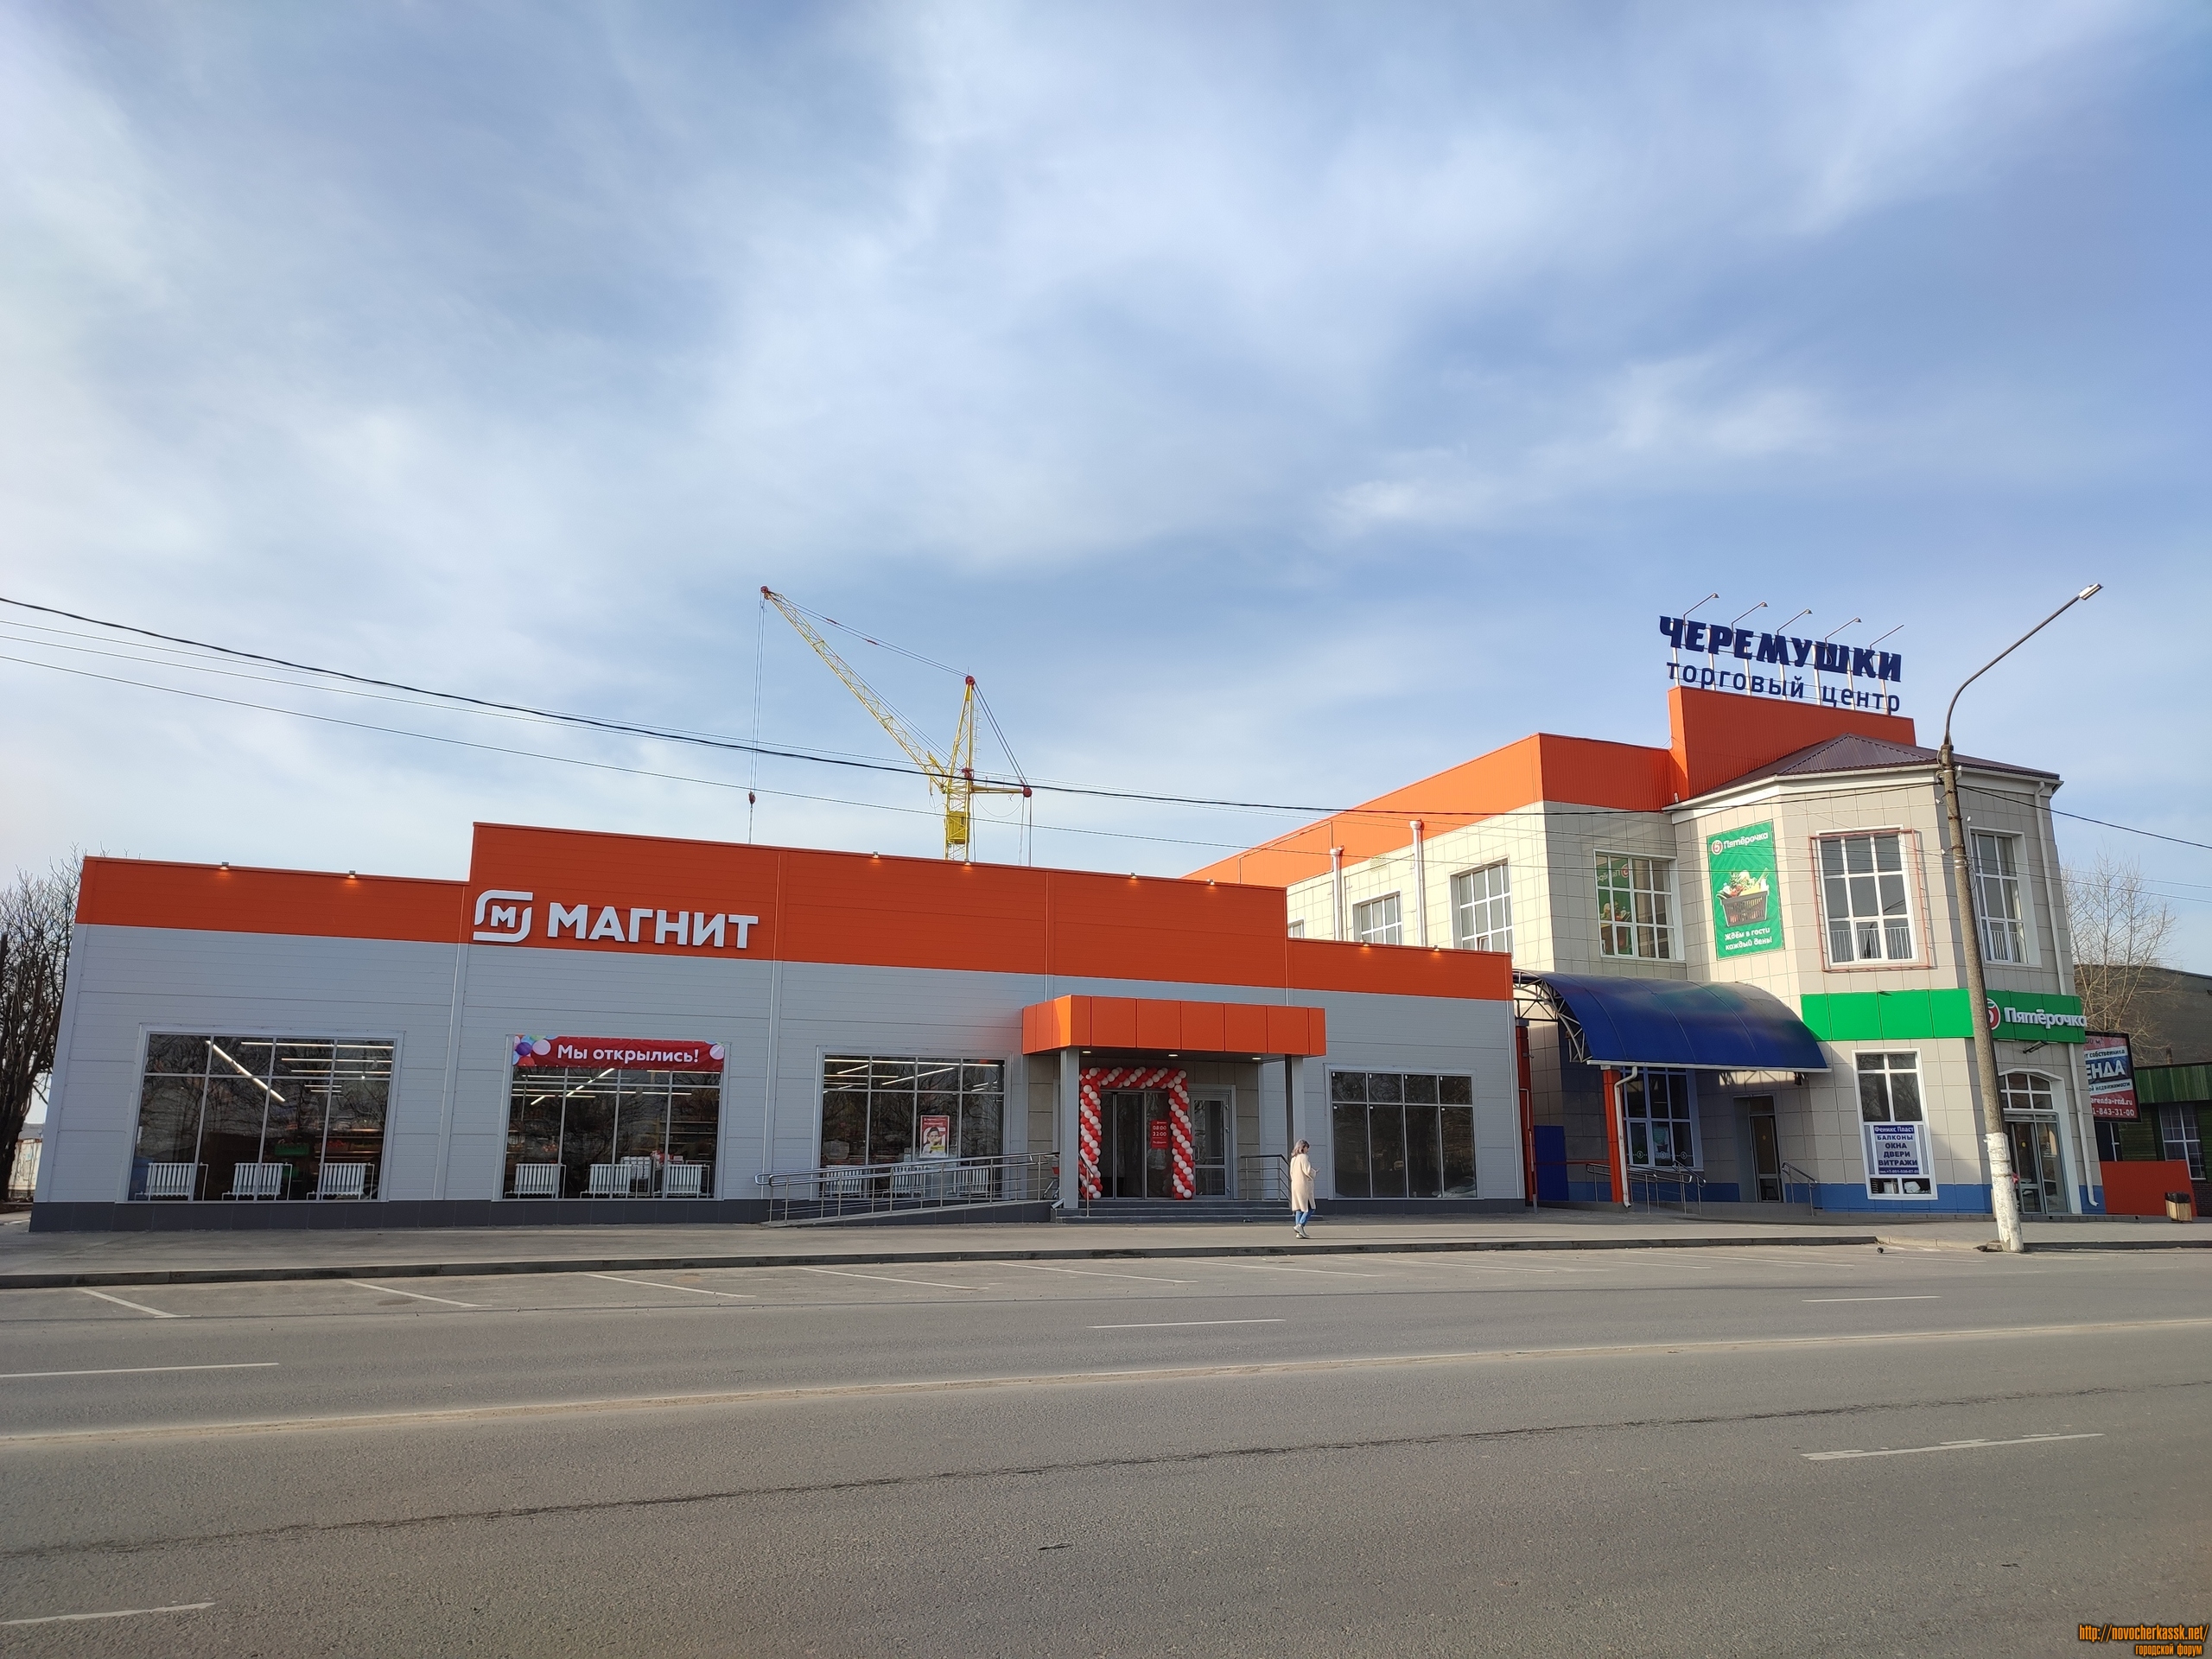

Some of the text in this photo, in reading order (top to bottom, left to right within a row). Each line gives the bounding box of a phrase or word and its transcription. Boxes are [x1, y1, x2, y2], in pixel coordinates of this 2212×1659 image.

[1660, 616, 1902, 683] ЧЕРЕМУШКИ
[1667, 662, 1900, 715] торговый центр
[1724, 832, 1769, 849] Пятёрочка
[547, 901, 759, 949] МАГНИТ
[1725, 931, 1745, 941] Ждём
[1726, 936, 1773, 950] каждый день!
[2004, 1007, 2088, 1029] Пятёрочка
[557, 1045, 699, 1064] Мы открылись!
